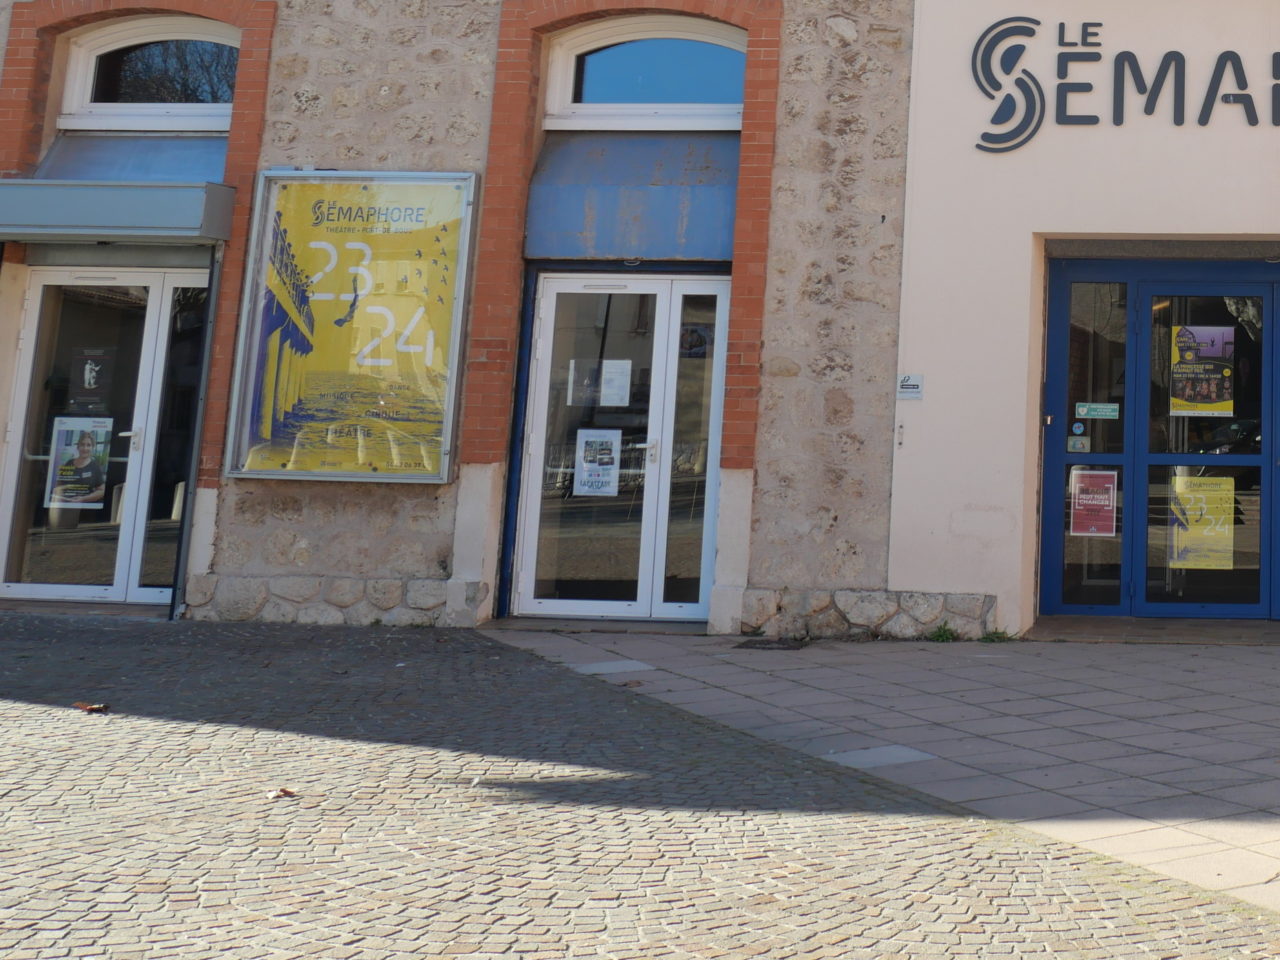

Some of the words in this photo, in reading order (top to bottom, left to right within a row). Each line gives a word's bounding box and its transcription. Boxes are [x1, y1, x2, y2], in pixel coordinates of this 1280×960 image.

[1059, 21, 1103, 47] LE
[308, 241, 374, 301] 23
[356, 305, 435, 367] 24
[1183, 494, 1207, 515] 23
[1202, 515, 1230, 537] 24
